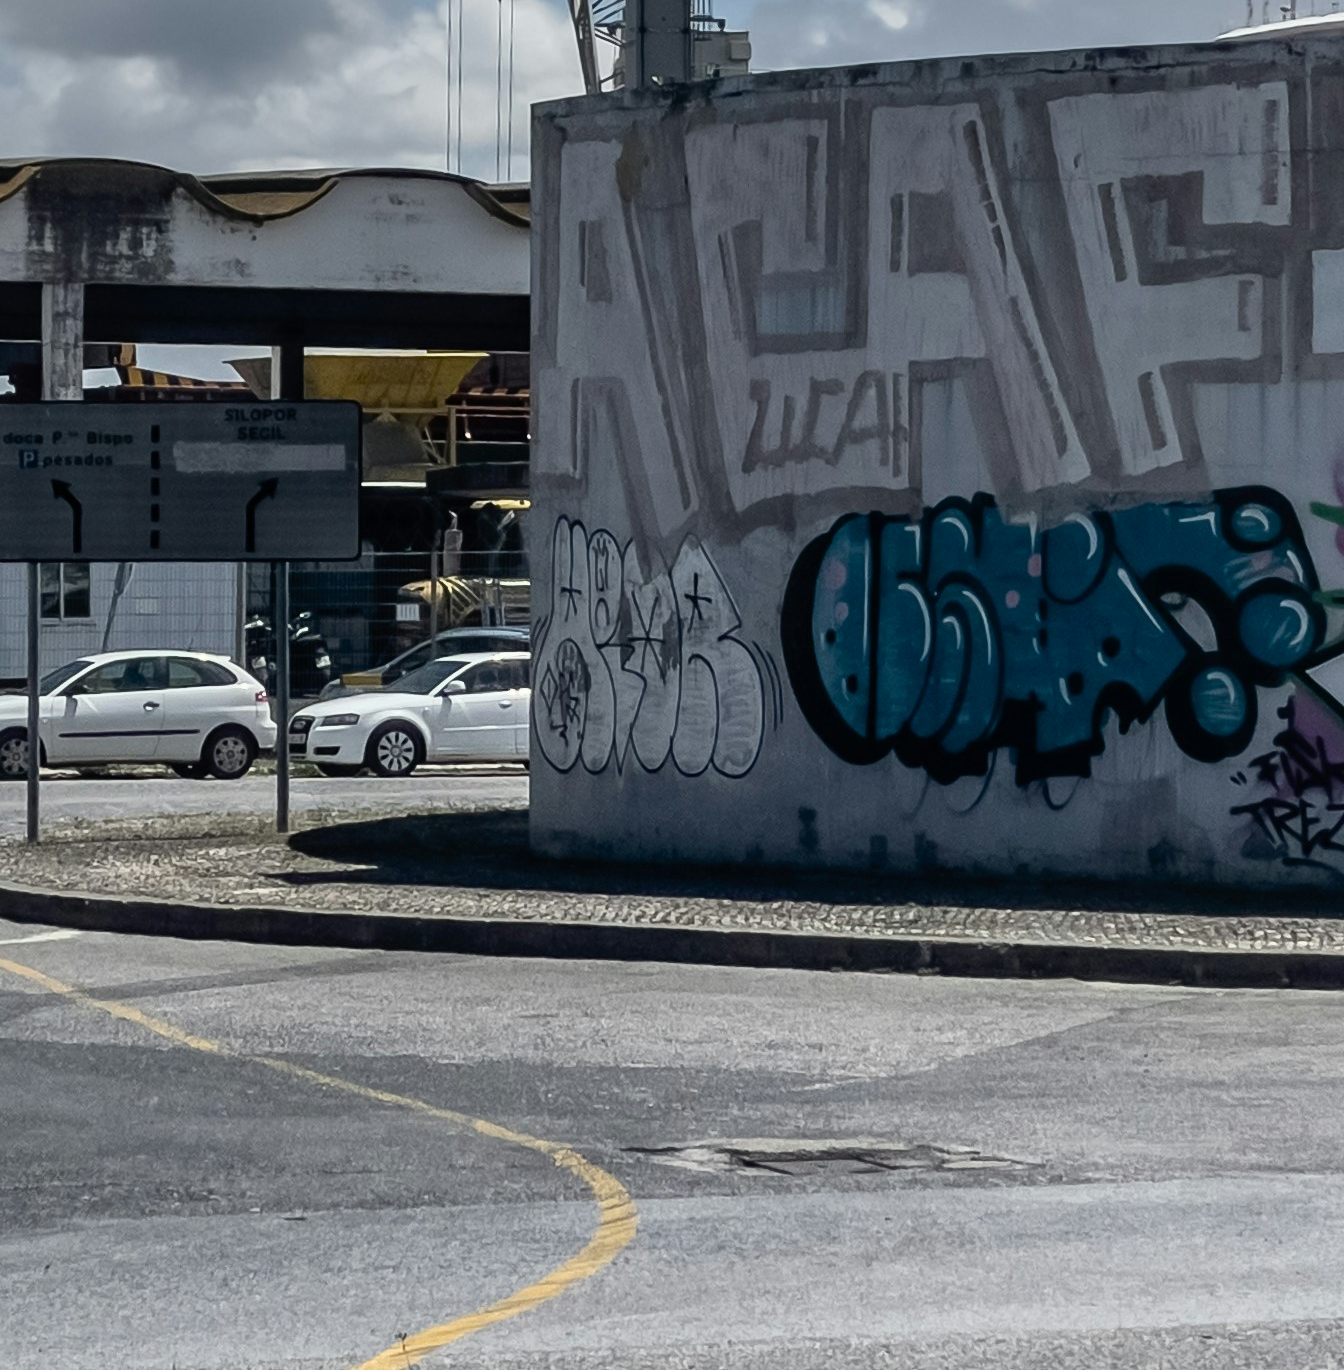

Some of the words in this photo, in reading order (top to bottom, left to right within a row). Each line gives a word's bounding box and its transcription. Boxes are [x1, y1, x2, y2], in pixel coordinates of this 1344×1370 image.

[224, 408, 297, 422] SILOPOR
[3, 432, 44, 445] doca
[87, 431, 133, 447] Bispo
[43, 454, 113, 468] pesados
